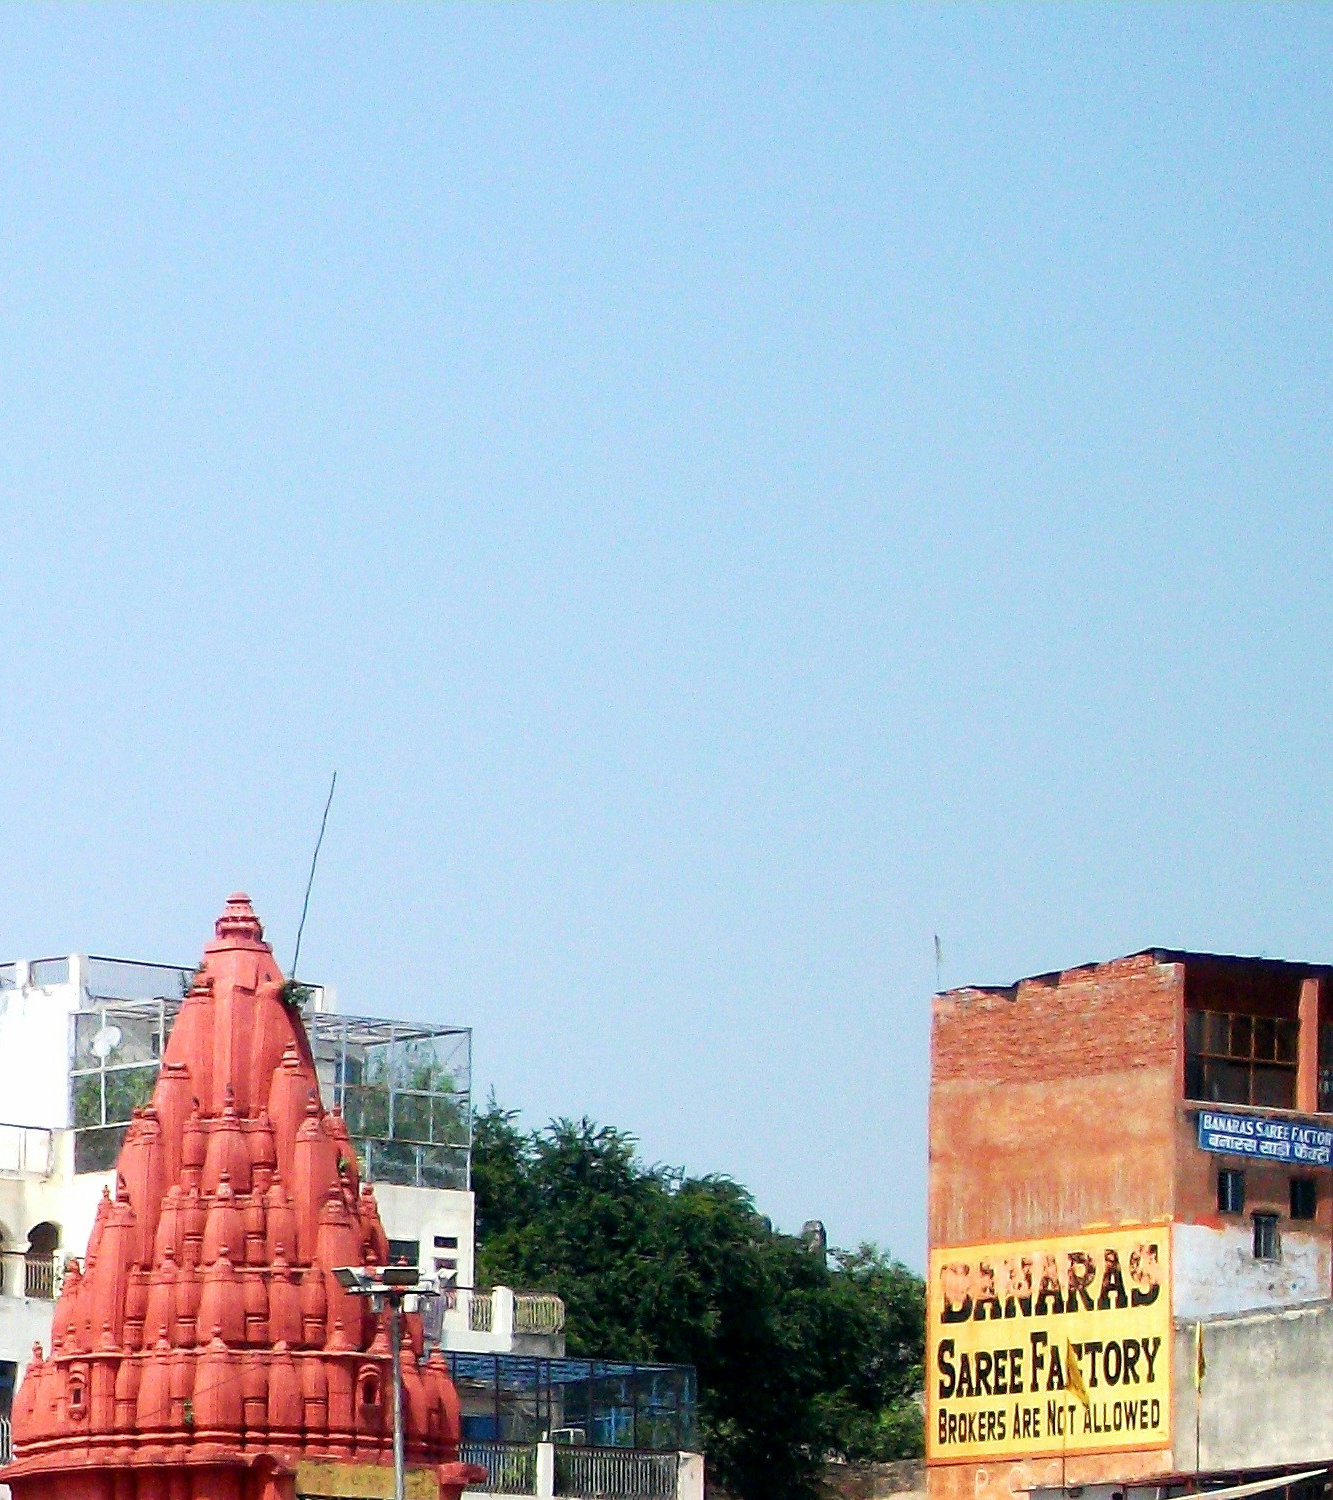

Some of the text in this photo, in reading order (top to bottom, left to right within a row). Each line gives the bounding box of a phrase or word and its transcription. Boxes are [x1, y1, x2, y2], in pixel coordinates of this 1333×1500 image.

[1203, 1114, 1254, 1136] BANARAS
[1255, 1121, 1290, 1140] SAREE
[940, 1243, 1161, 1324] BANARAS
[937, 1338, 1024, 1400] SAREE
[938, 1397, 1161, 1445] BROKERS ARE NOT ALLOWED
